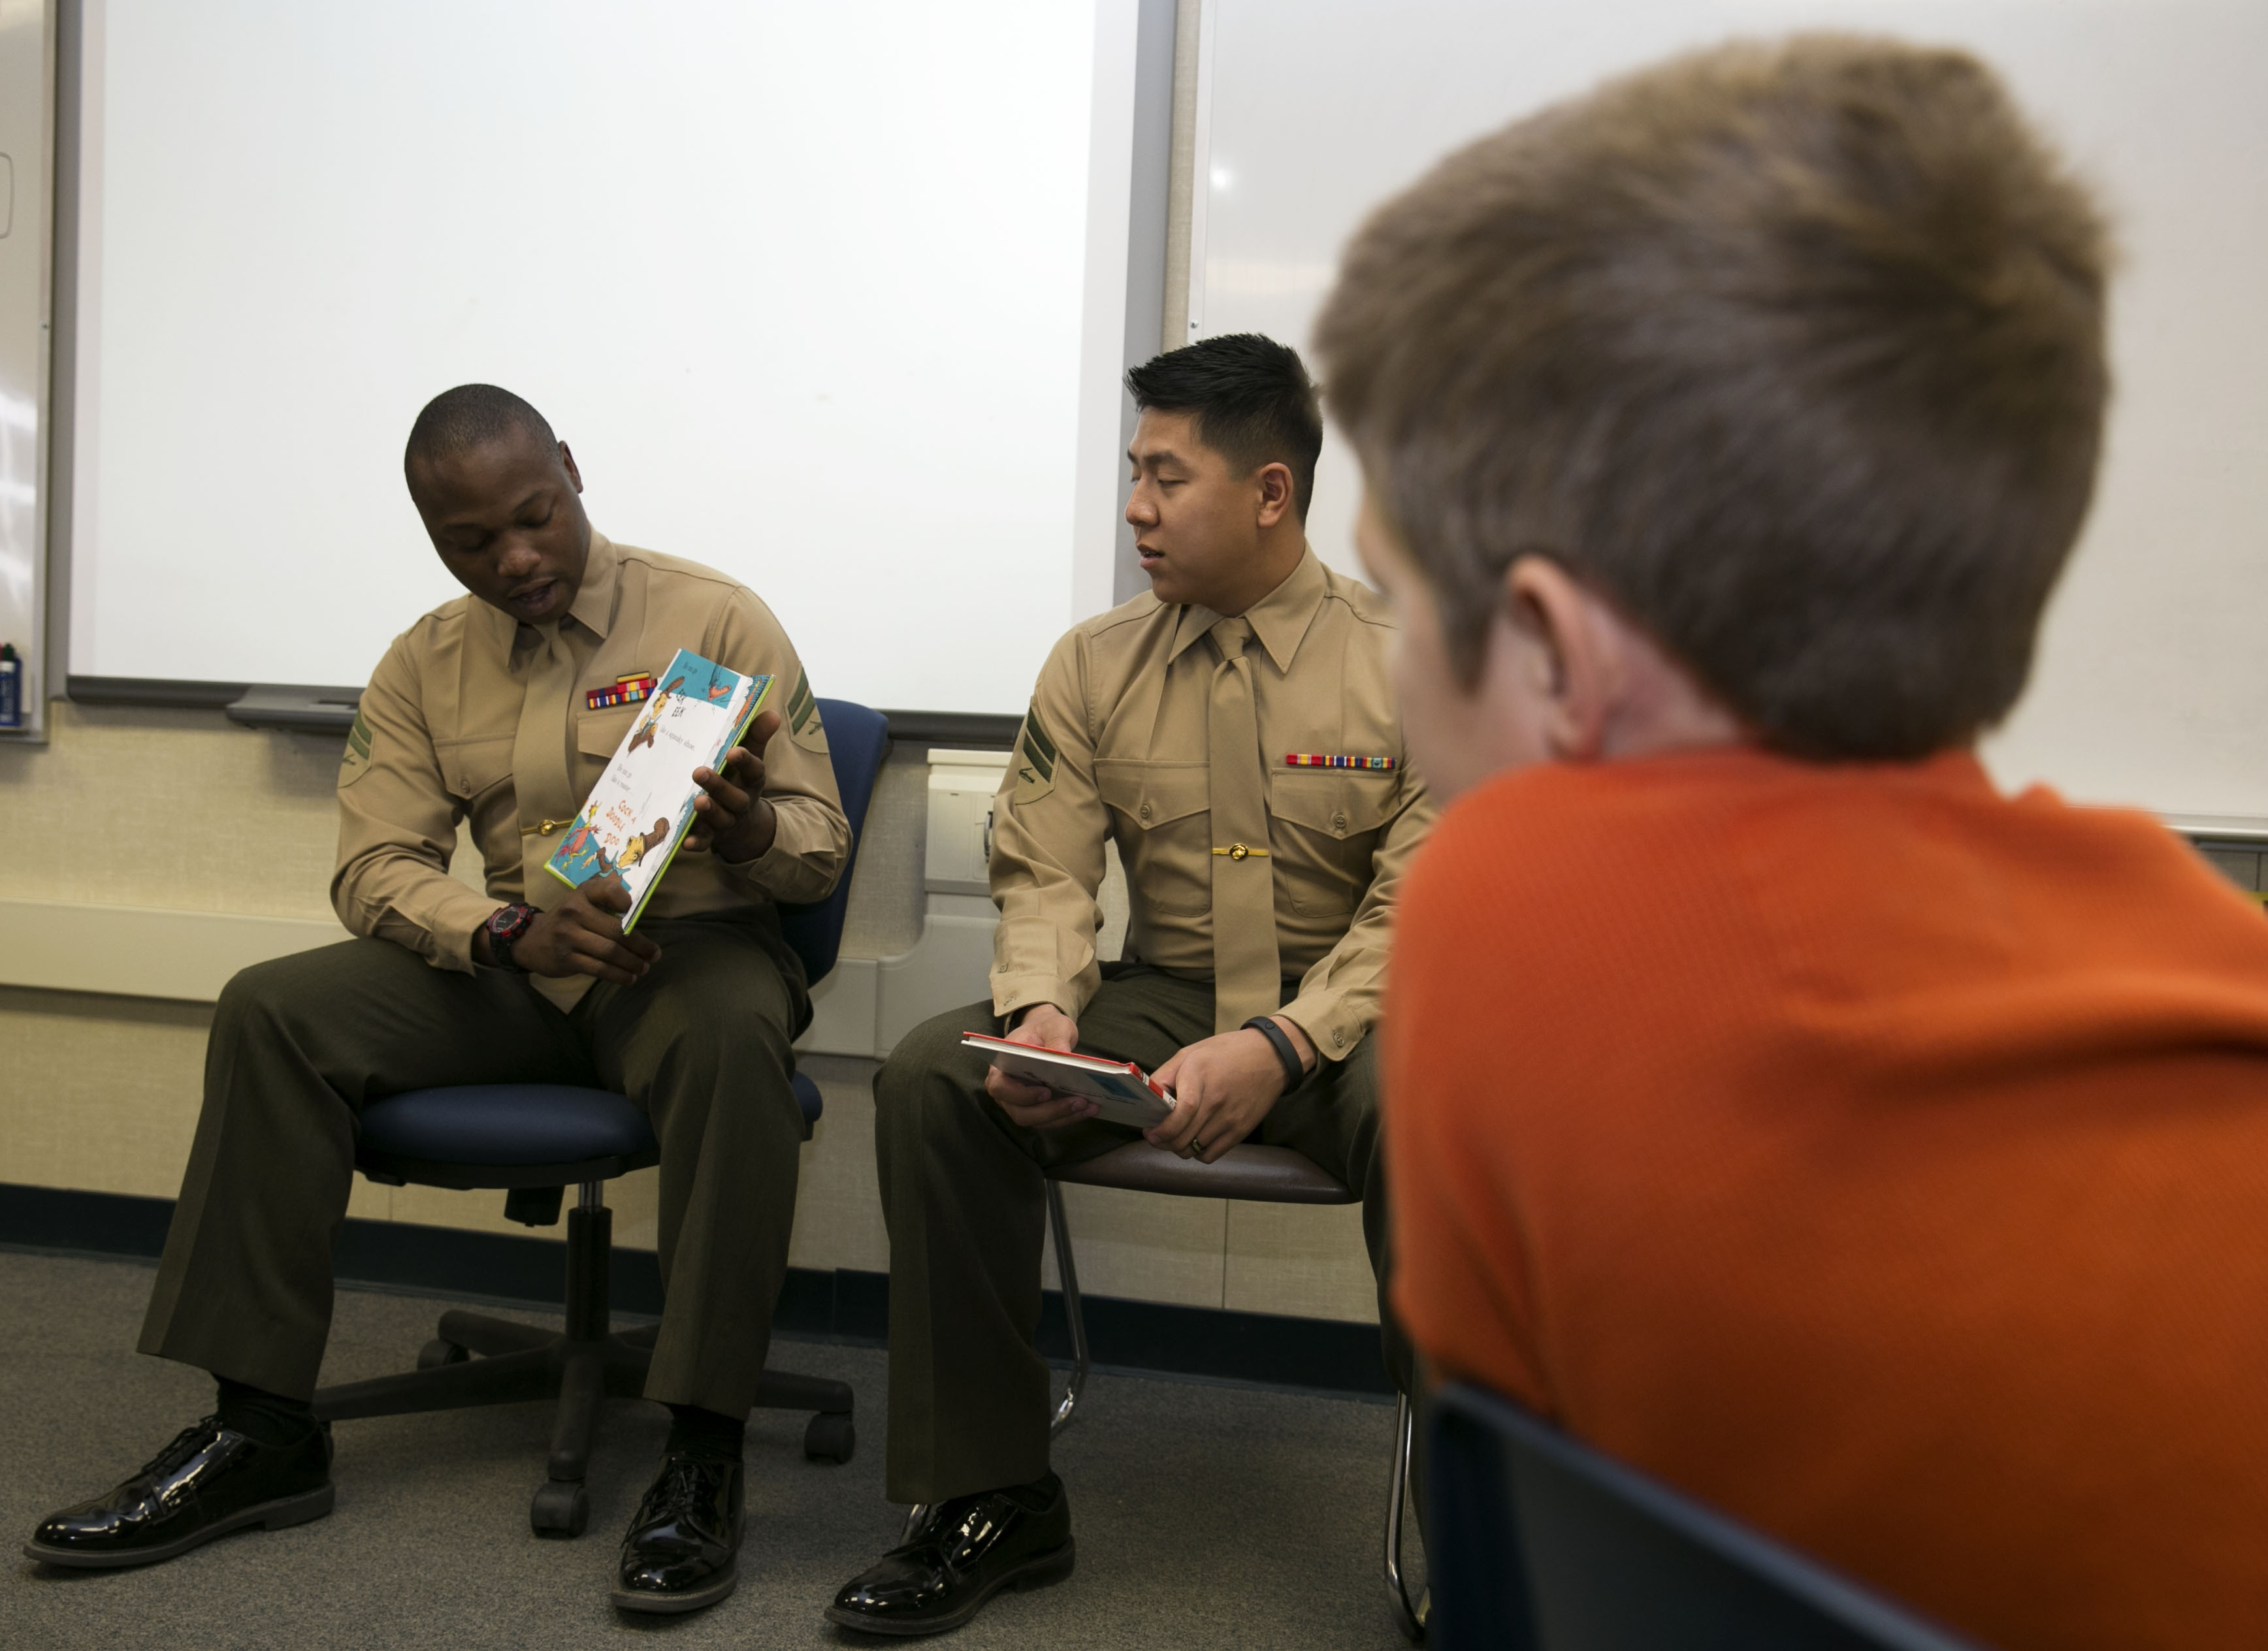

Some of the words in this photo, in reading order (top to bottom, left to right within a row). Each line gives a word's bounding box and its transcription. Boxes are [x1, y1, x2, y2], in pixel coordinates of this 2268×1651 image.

[671, 706, 686, 718] EEK
[618, 799, 634, 817] COCK
[606, 806, 626, 831] DOODLE
[604, 833, 620, 846] DOO
